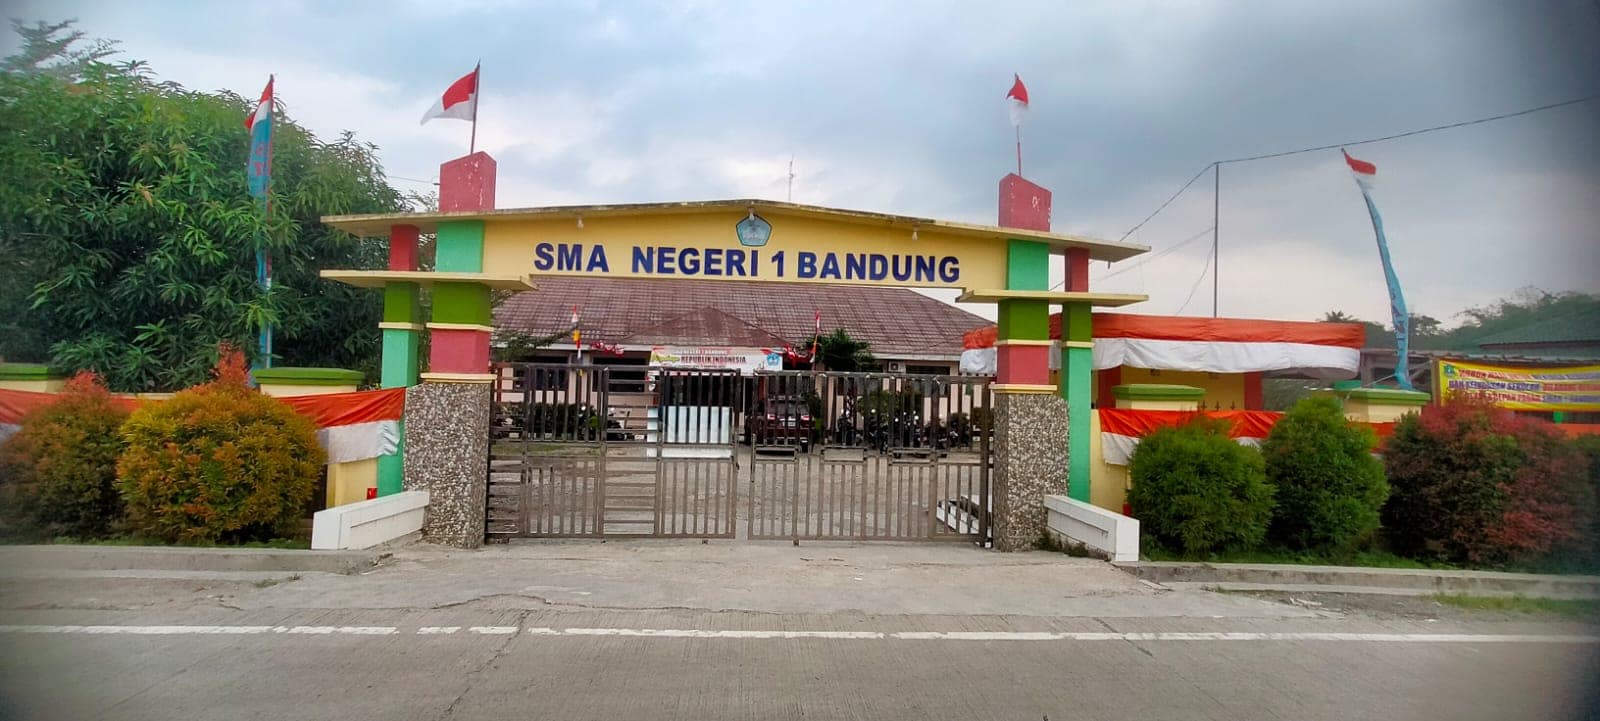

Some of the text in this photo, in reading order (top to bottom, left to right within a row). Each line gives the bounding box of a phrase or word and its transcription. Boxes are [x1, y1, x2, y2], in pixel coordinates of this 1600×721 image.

[534, 243, 961, 283] SMA NEGERI 1 BANDUNG
[680, 355, 711, 363] REPUBLIK
